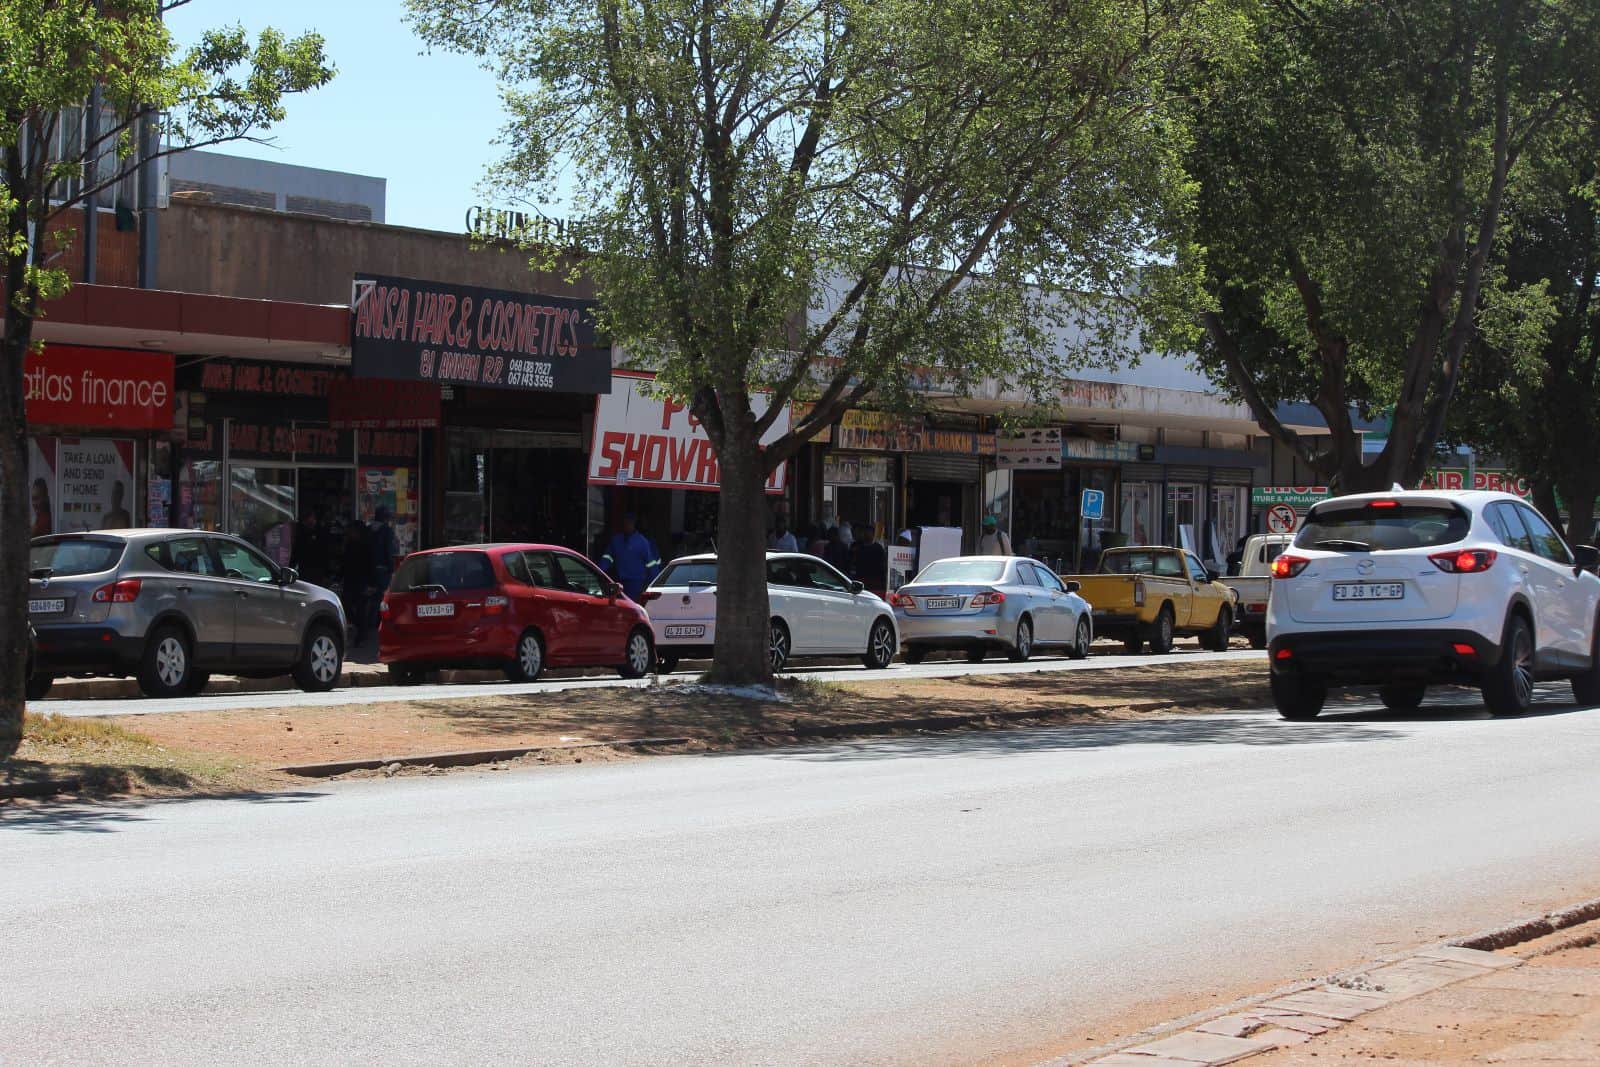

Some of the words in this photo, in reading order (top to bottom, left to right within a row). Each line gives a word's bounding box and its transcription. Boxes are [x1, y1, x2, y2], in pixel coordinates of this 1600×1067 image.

[477, 298, 580, 358] COSMETICS
[24, 366, 73, 402] atlas
[81, 370, 167, 407] finance
[64, 451, 84, 464] TAKE
[85, 452, 92, 464] A
[93, 453, 116, 465] LOAN
[598, 431, 777, 488] SHOWR
[64, 468, 81, 480] AND
[82, 468, 105, 480] SEND
[64, 483, 71, 495] IT
[72, 483, 99, 496] HOME
[1418, 471, 1464, 490] AIR
[1473, 472, 1532, 497] PRIC
[1087, 492, 1099, 507] P
[1253, 495, 1277, 503] ITURE
